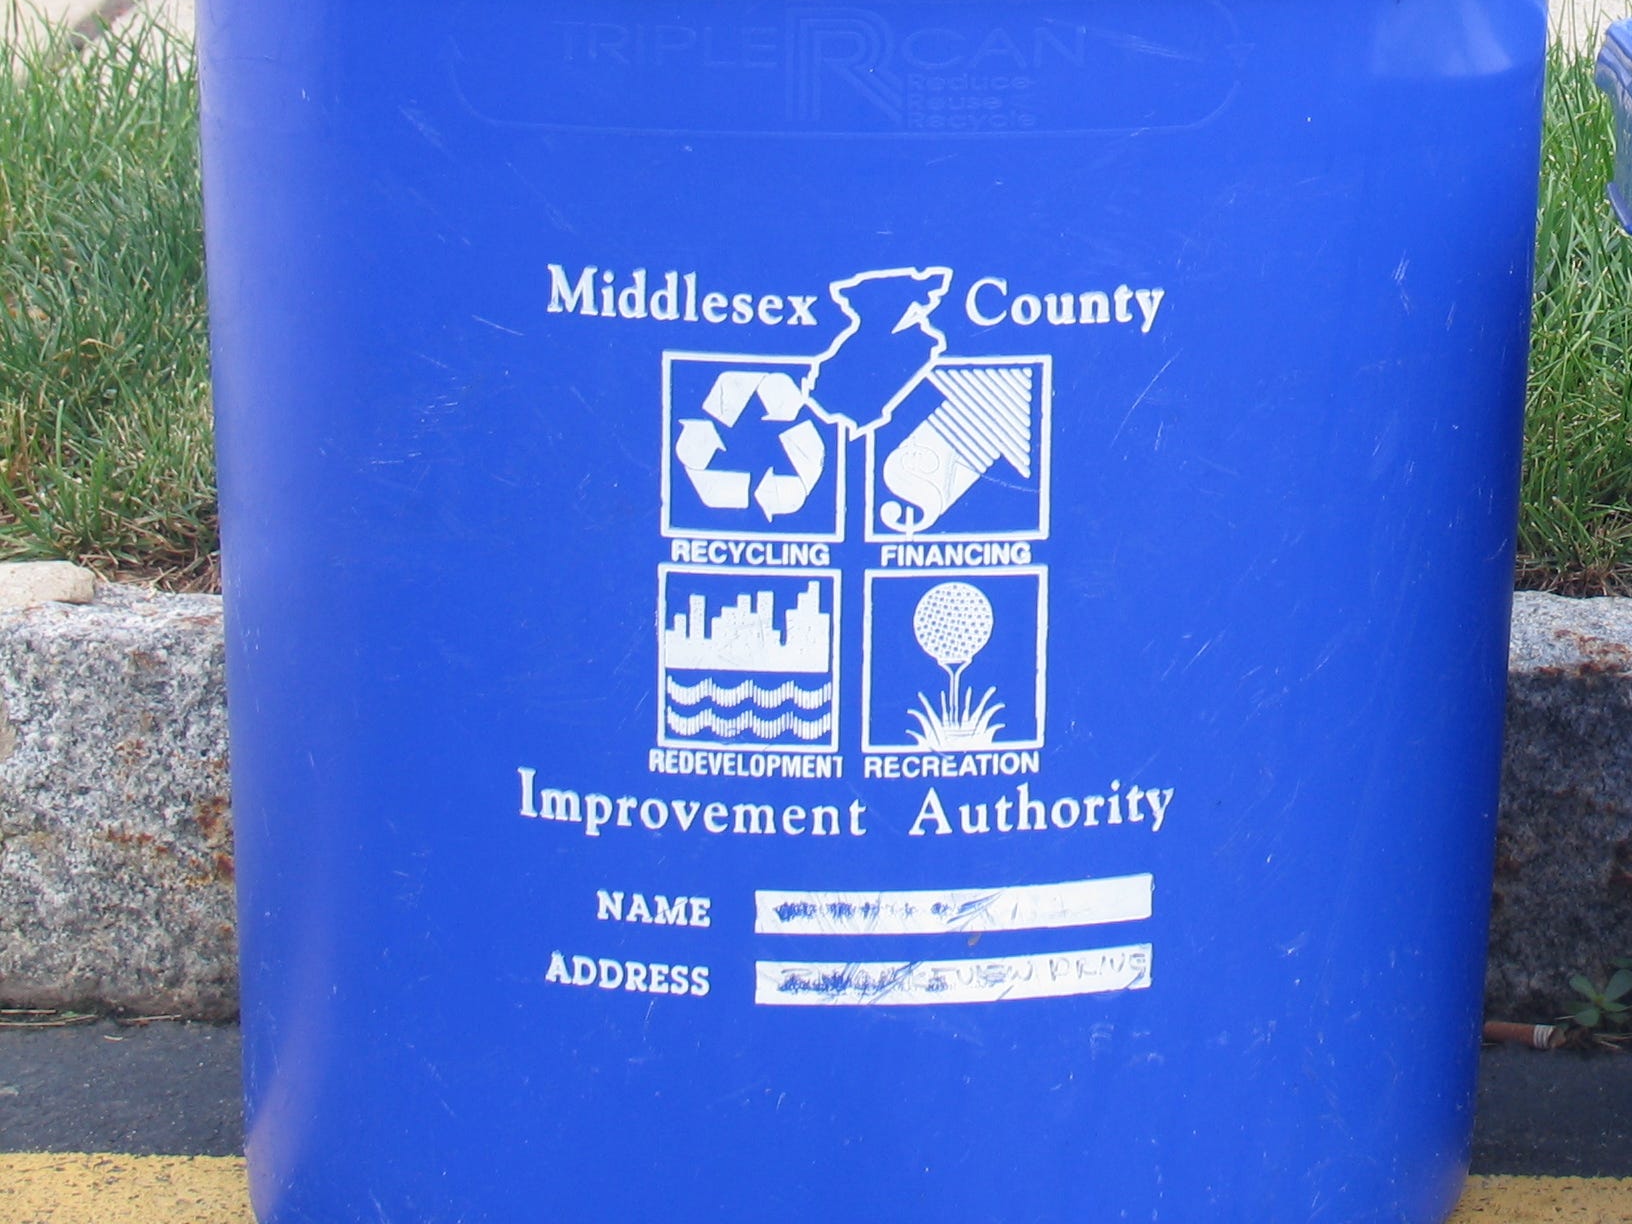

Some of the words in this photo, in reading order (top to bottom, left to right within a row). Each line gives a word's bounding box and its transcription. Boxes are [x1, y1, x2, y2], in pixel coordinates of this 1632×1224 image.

[553, 20, 778, 69] TRIPLE
[901, 24, 1088, 69] CAN
[547, 264, 817, 325] Middlesex
[965, 277, 1165, 333] County
[671, 540, 830, 566] RECYCLING
[881, 542, 1031, 566] FINANCING
[649, 749, 843, 778] REDEVELOPMENT
[864, 751, 1039, 778] RECREATION
[518, 767, 867, 836] Improvement
[909, 780, 1174, 836] Authority
[597, 890, 711, 927] NAME
[546, 952, 710, 996] ADDRESS
